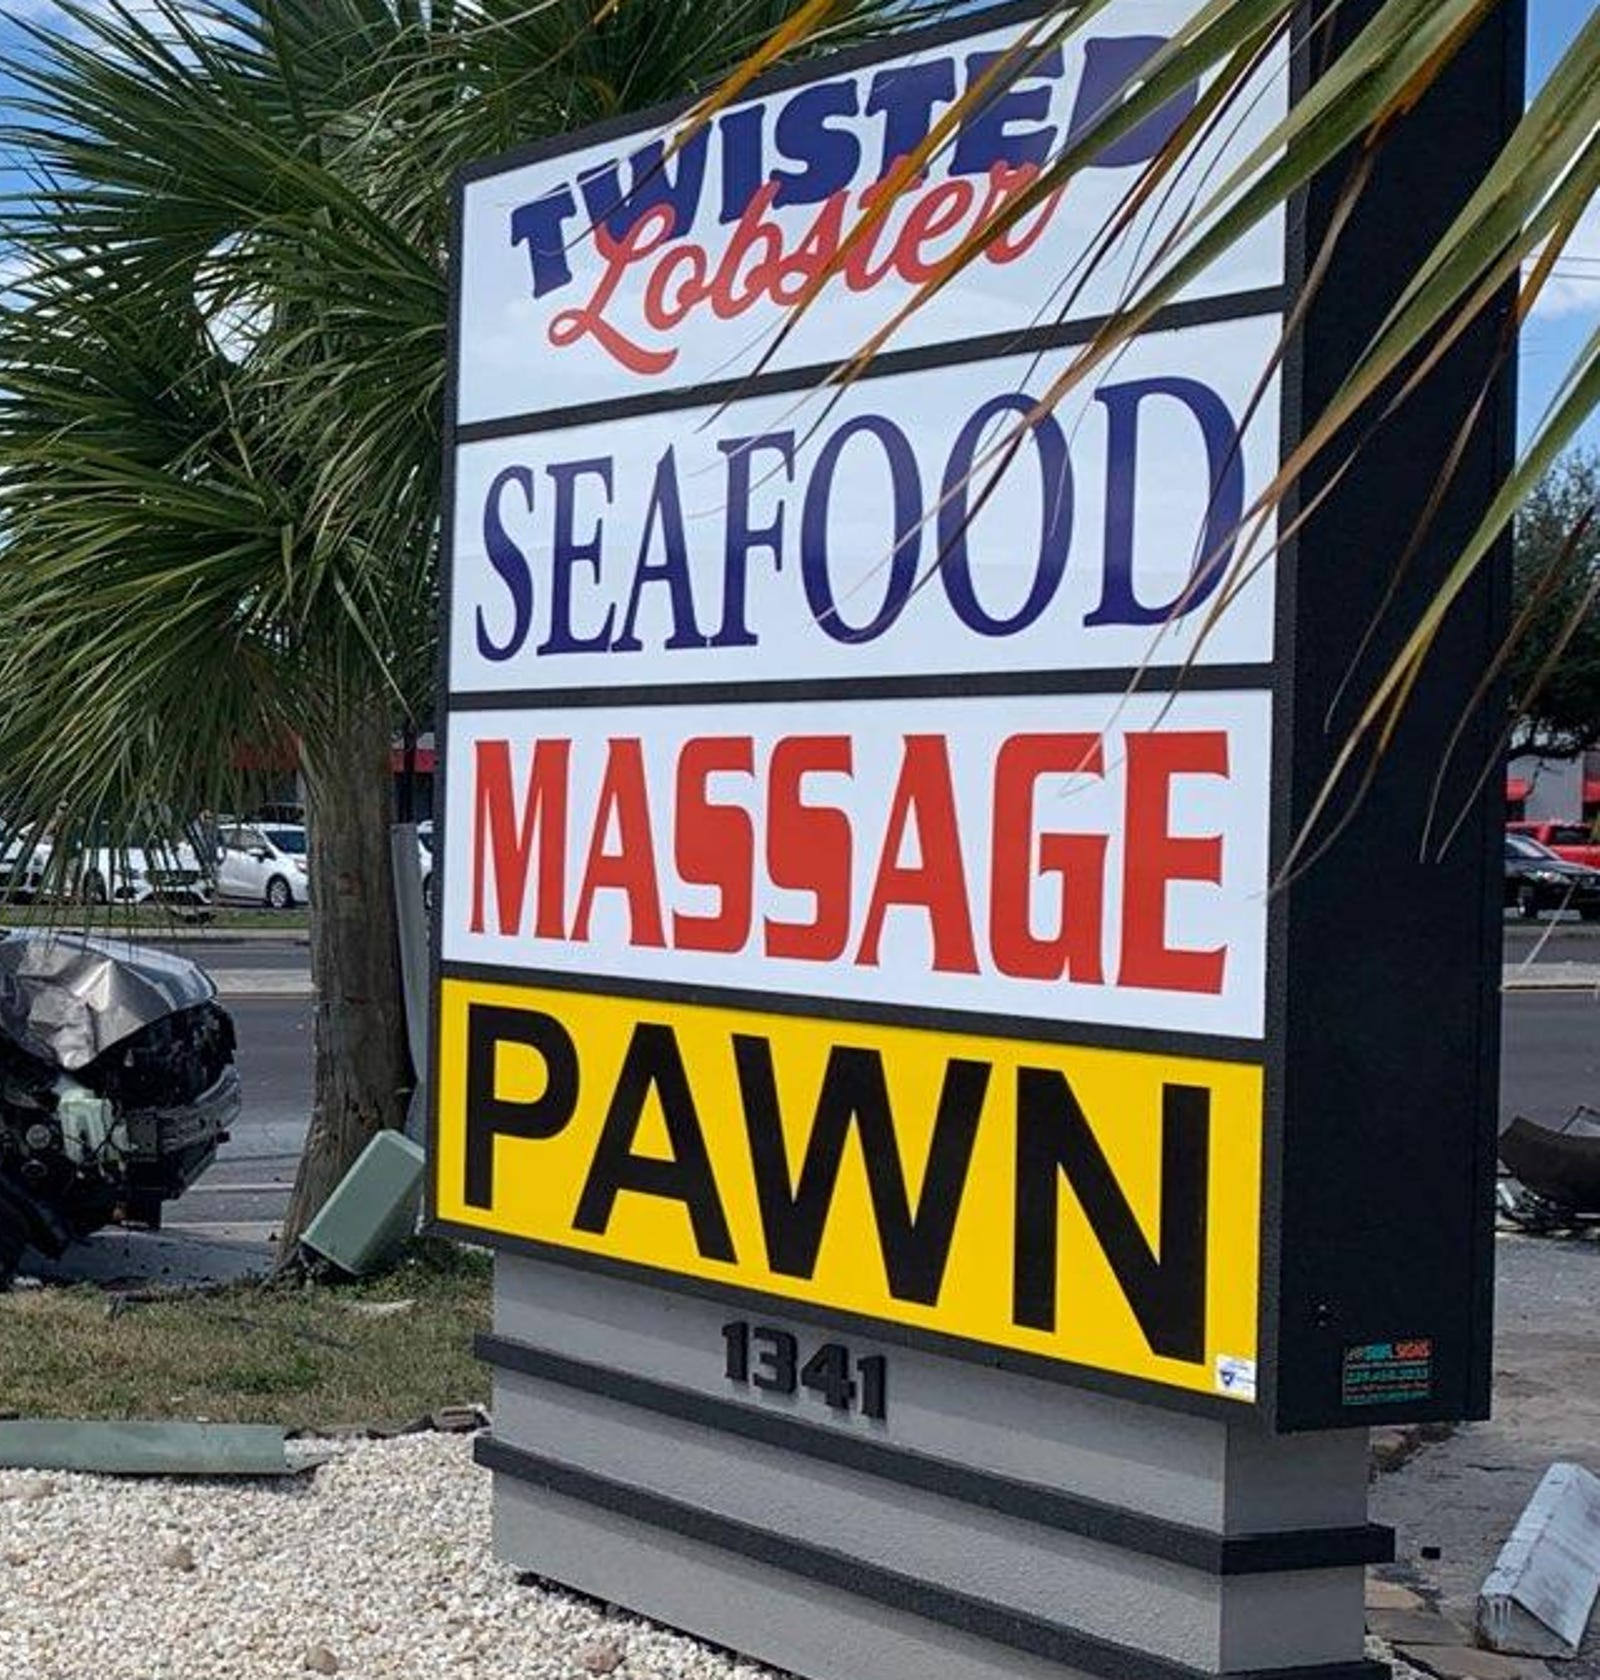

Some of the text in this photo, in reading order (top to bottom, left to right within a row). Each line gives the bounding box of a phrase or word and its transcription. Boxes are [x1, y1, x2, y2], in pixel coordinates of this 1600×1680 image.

[510, 34, 1198, 298] TWISTED
[547, 157, 1067, 376] Lobster
[475, 375, 1246, 662] SEAFOOD
[470, 730, 1230, 995] MASSAGE
[463, 1002, 1208, 1366] PAWN
[721, 1320, 887, 1421] 1341
